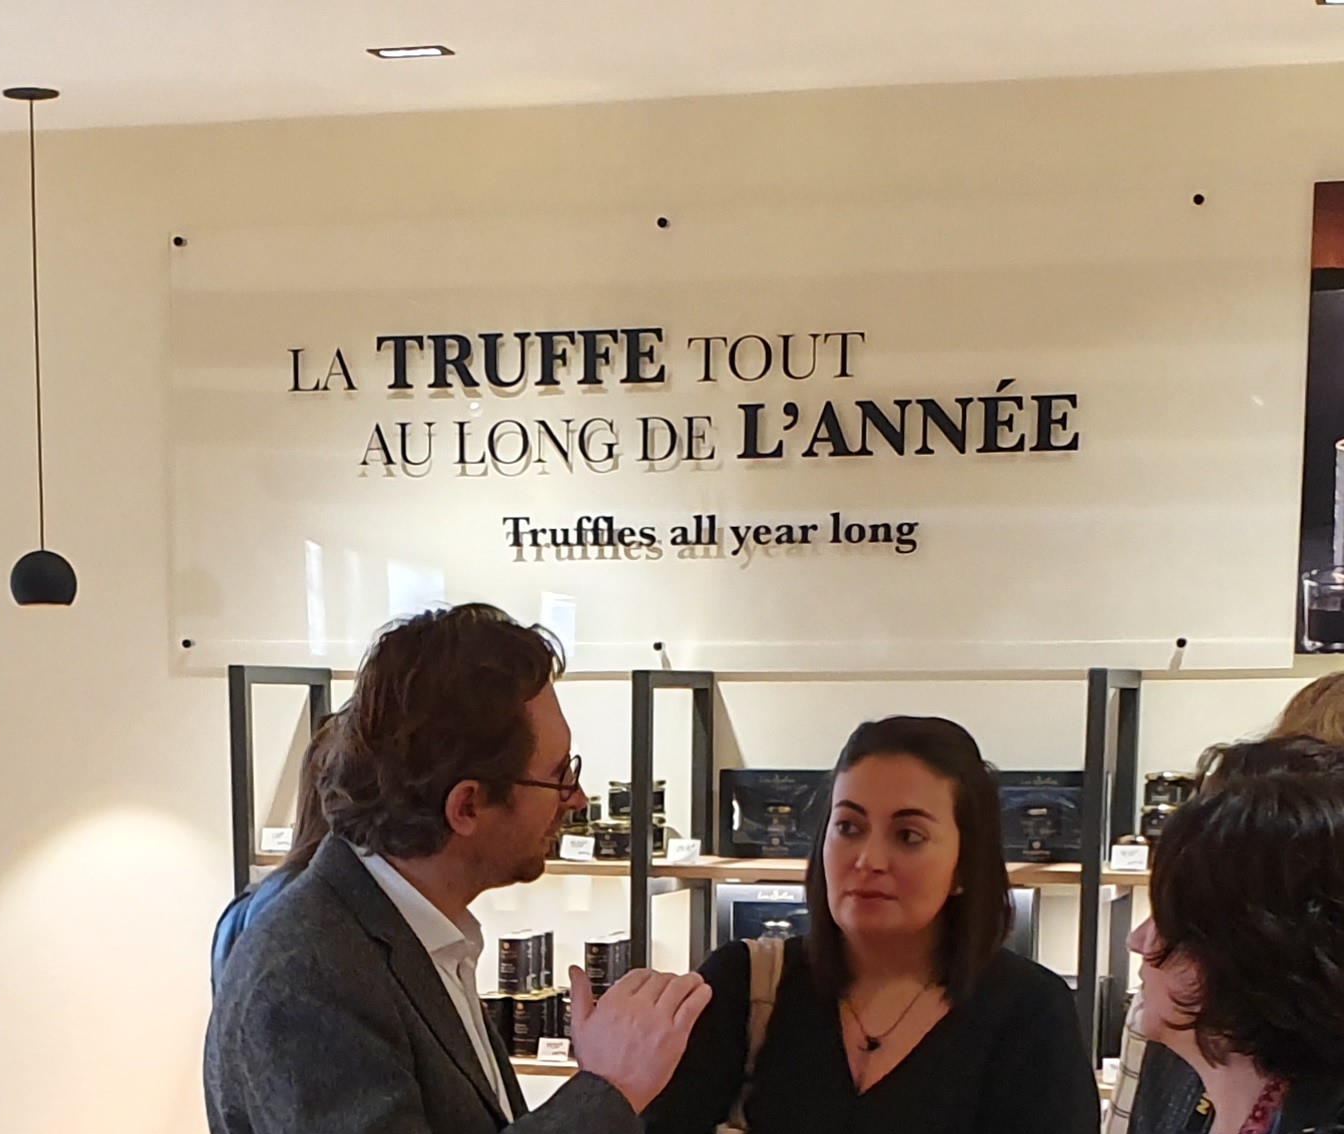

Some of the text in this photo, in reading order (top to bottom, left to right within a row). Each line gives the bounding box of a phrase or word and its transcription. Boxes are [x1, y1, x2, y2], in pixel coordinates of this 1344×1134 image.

[288, 328, 865, 392] LA TRUFFE TOUT
[360, 378, 1079, 466] AU LONG DE L’ANNÉE
[502, 511, 920, 556] Truffles all year long
